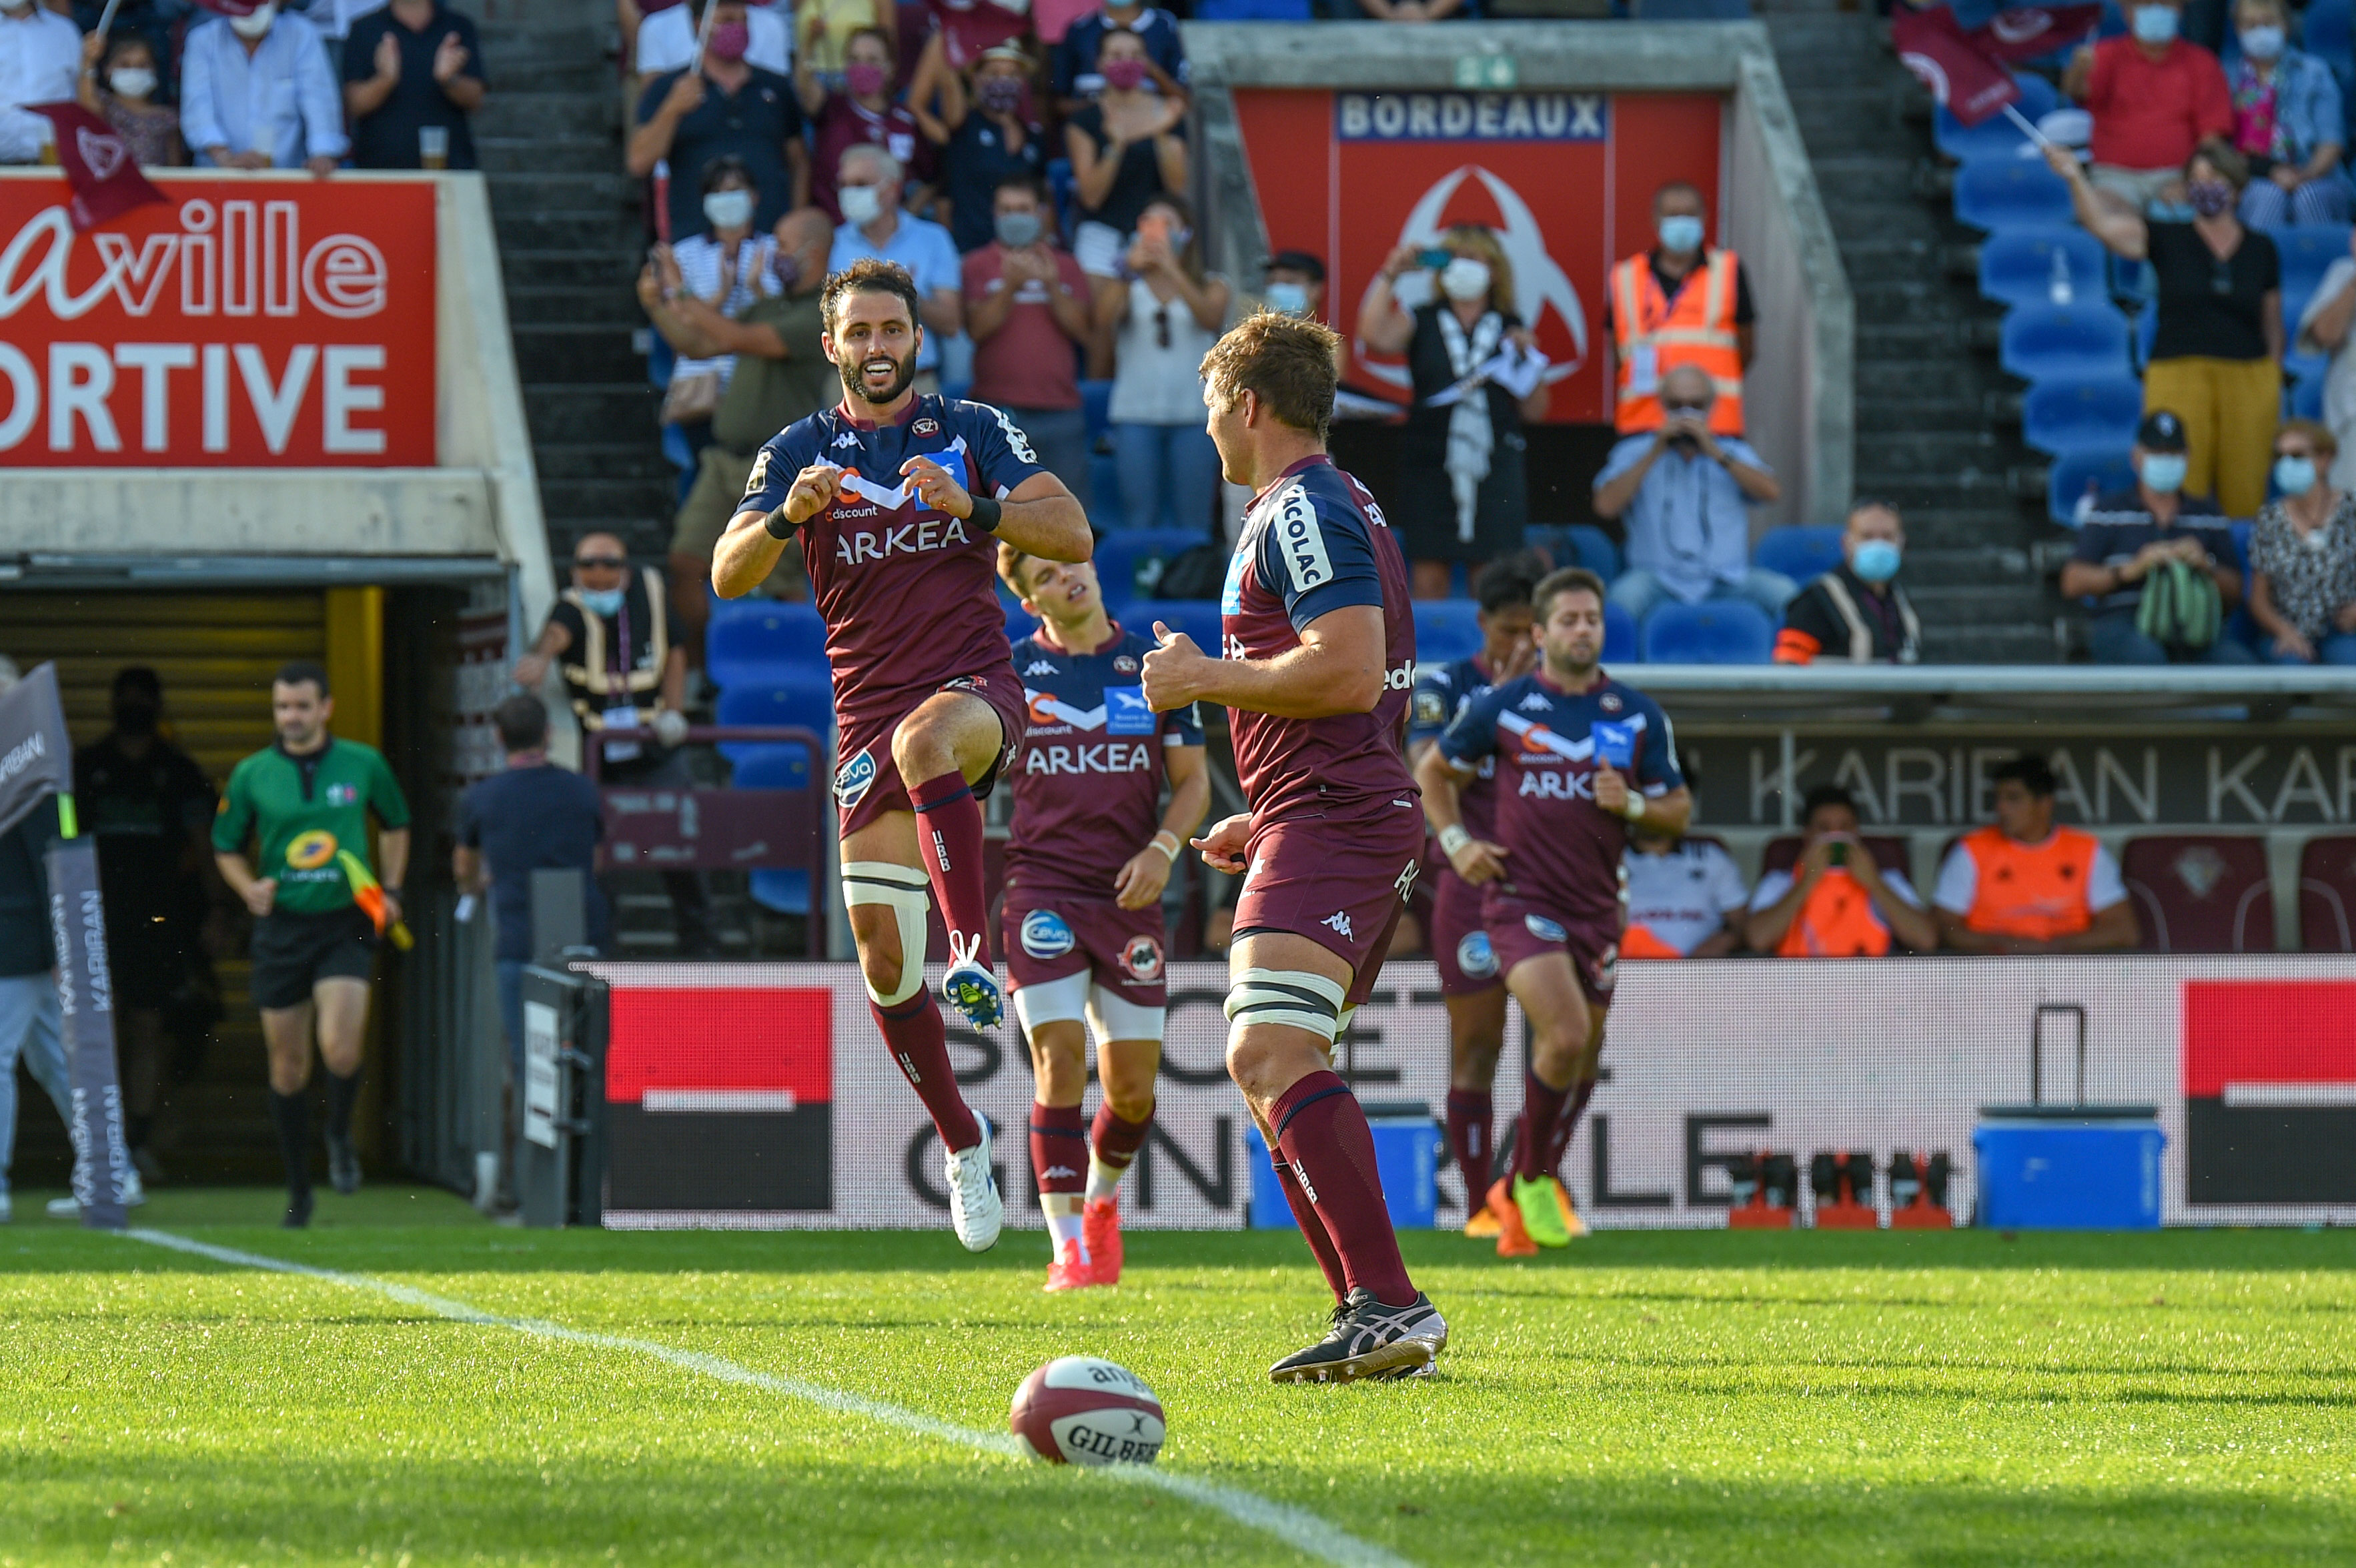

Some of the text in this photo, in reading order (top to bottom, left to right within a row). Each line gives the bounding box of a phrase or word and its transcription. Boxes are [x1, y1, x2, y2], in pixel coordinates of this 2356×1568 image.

[1341, 94, 1602, 138] BORDEAUX
[825, 505, 878, 522] cdscount
[835, 517, 971, 566] ARKEA
[1283, 489, 1321, 585] ACOLAC
[836, 762, 872, 786] eva
[1025, 742, 1151, 776] ARKEA
[1518, 770, 1595, 800] ARK
[2208, 745, 2356, 824] KA
[933, 830, 952, 872] UBB
[898, 1051, 921, 1084] UBB
[1293, 1158, 1318, 1205] UBB
